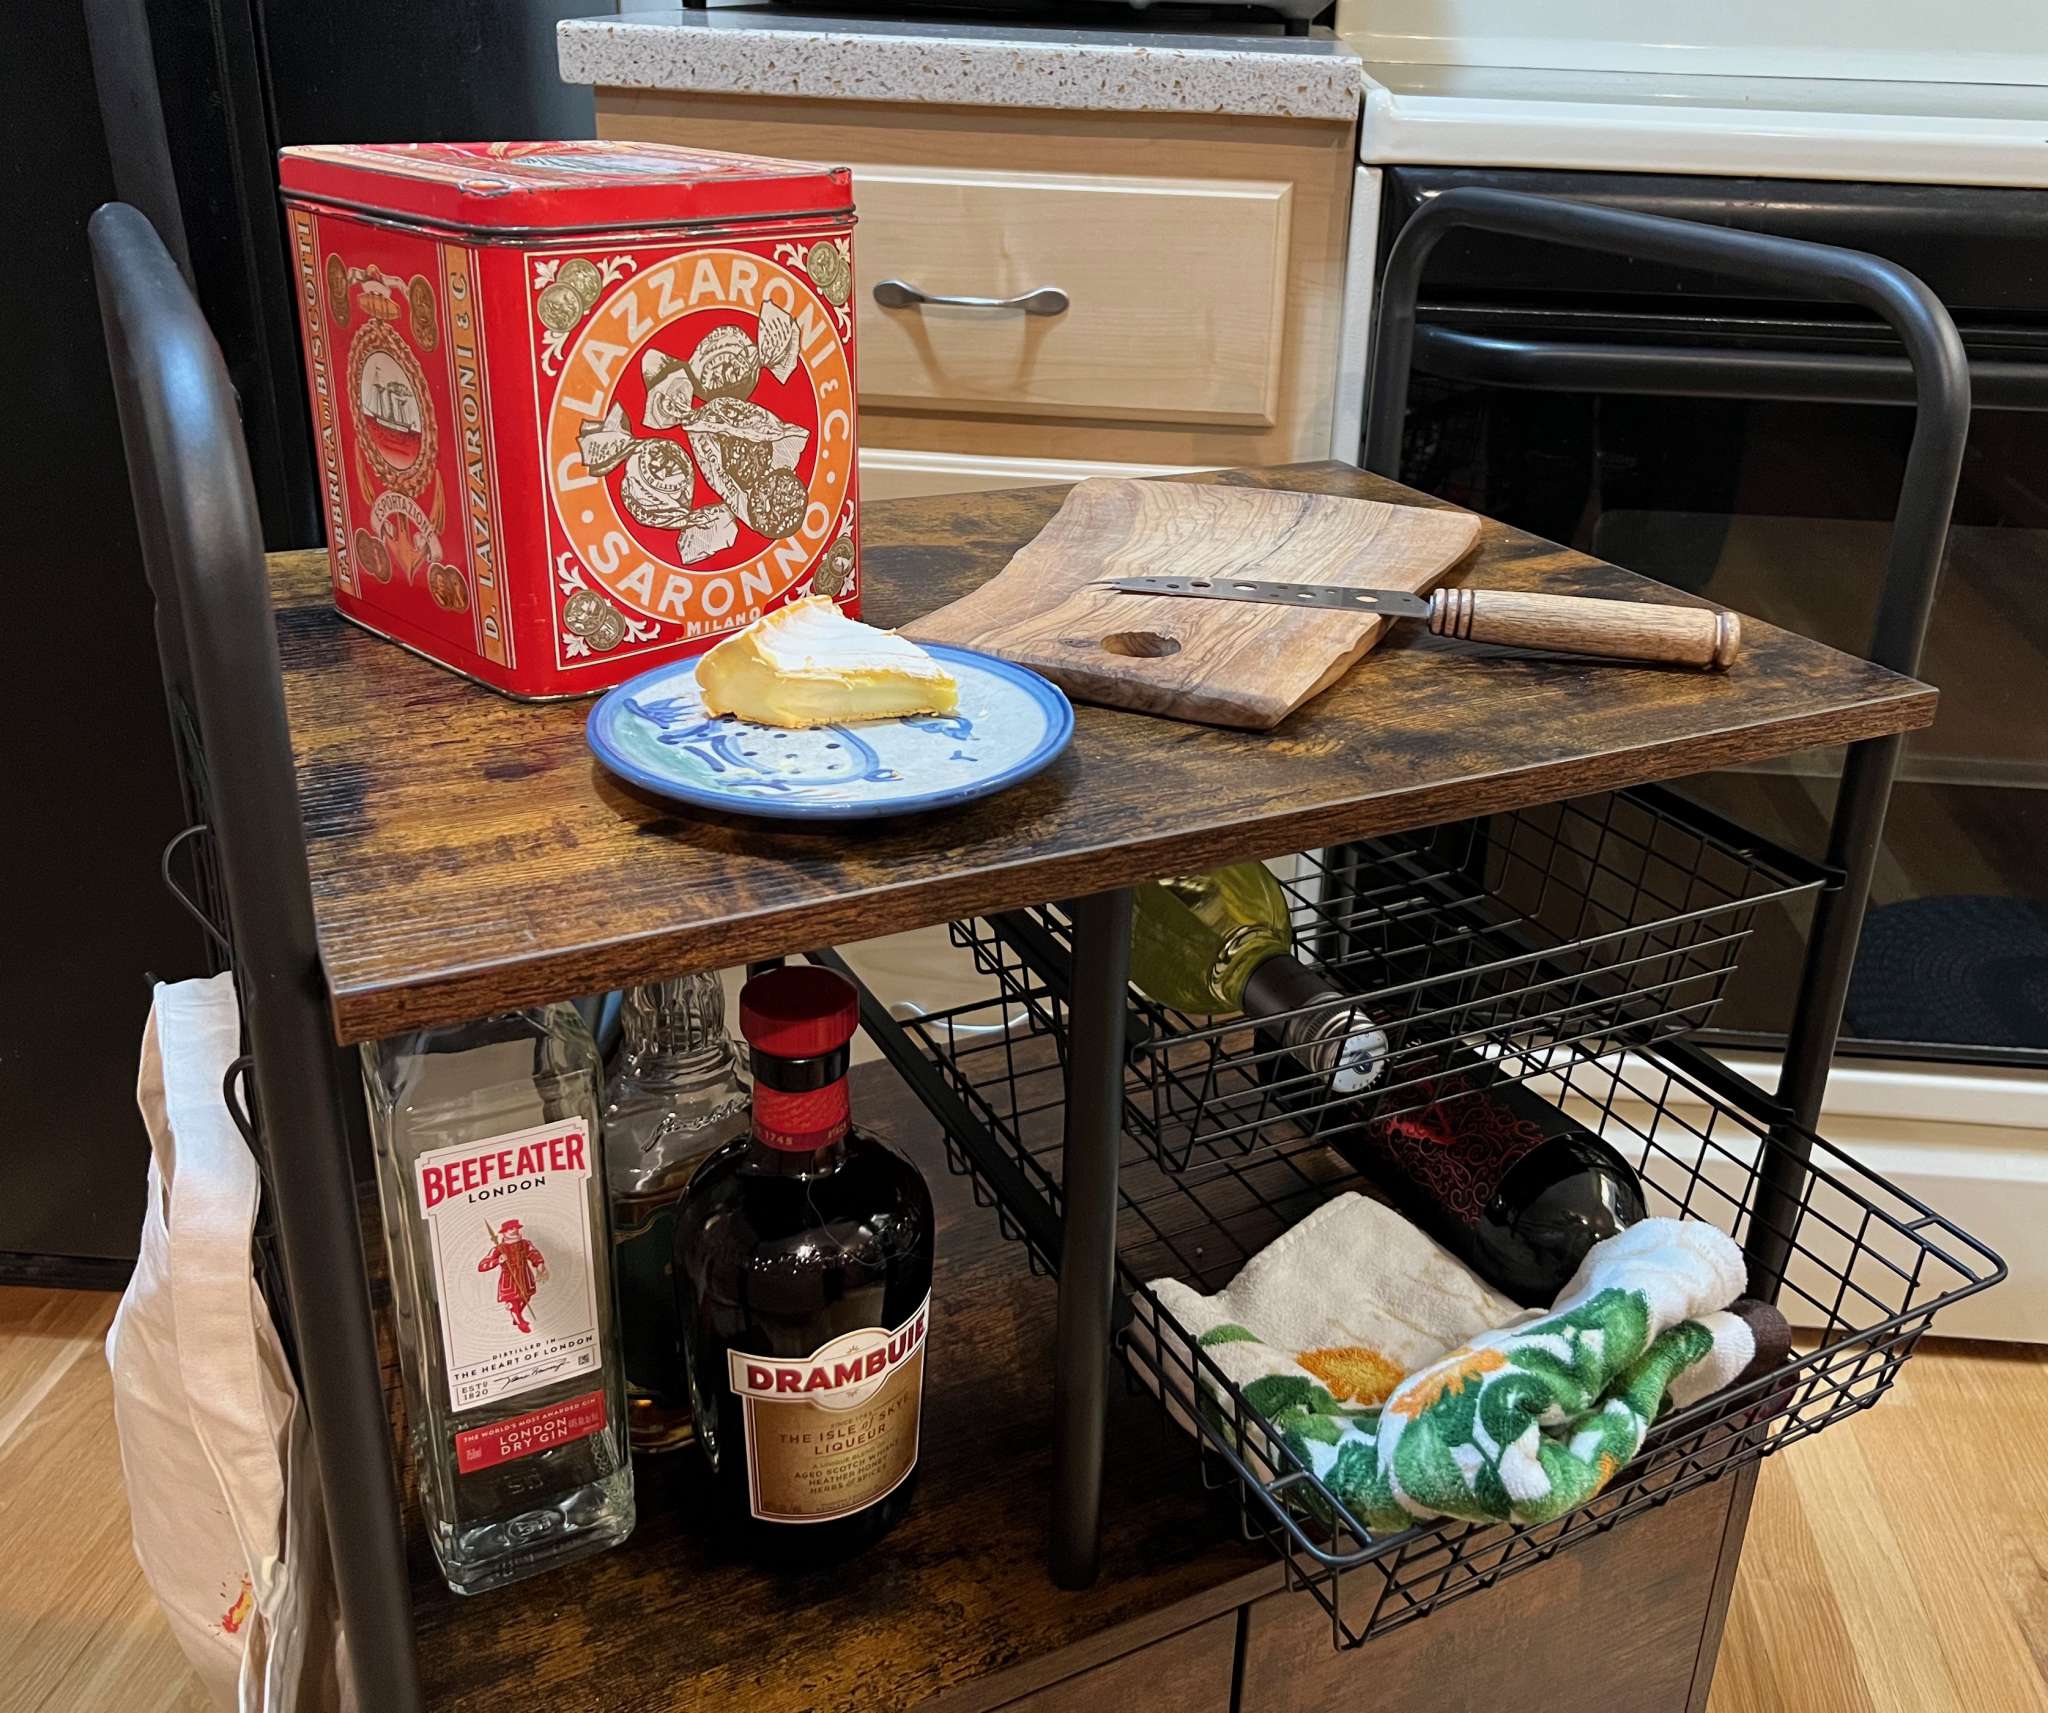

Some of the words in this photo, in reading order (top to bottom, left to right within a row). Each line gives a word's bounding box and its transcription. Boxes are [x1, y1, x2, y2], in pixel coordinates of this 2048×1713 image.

[297, 222, 328, 395] BISCOTTI
[561, 257, 837, 418] LAZZARONI
[456, 344, 495, 590] LAZZARONI
[322, 427, 351, 584] FABBRICA
[587, 501, 830, 618] SARONNO
[686, 606, 762, 639] MILANO
[422, 1133, 586, 1209] BEEFEATER
[468, 1176, 546, 1203] LONDON
[453, 1369, 477, 1381] THE
[481, 1357, 520, 1374] HEART
[524, 1352, 539, 1361] OF
[543, 1335, 594, 1355] LONDON
[492, 1341, 542, 1361] DISTILLED
[545, 1337, 557, 1345] IN
[746, 1309, 926, 1393] DRAMBUIE
[463, 1388, 489, 1401] 1820
[463, 1433, 479, 1443] THE
[481, 1422, 517, 1437] WORLD'S
[518, 1415, 541, 1426] MOST
[542, 1403, 580, 1419] AWARDED
[499, 1416, 568, 1446] LONDON
[780, 1433, 812, 1444] THE
[819, 1424, 857, 1442] ISLE
[814, 1423, 887, 1455] LIQUEUR
[501, 1437, 533, 1456] DRY
[539, 1426, 568, 1443] GIN
[794, 1470, 823, 1479] AGED
[826, 1459, 865, 1476] SCOTCH
[808, 1470, 856, 1486] HEATHER
